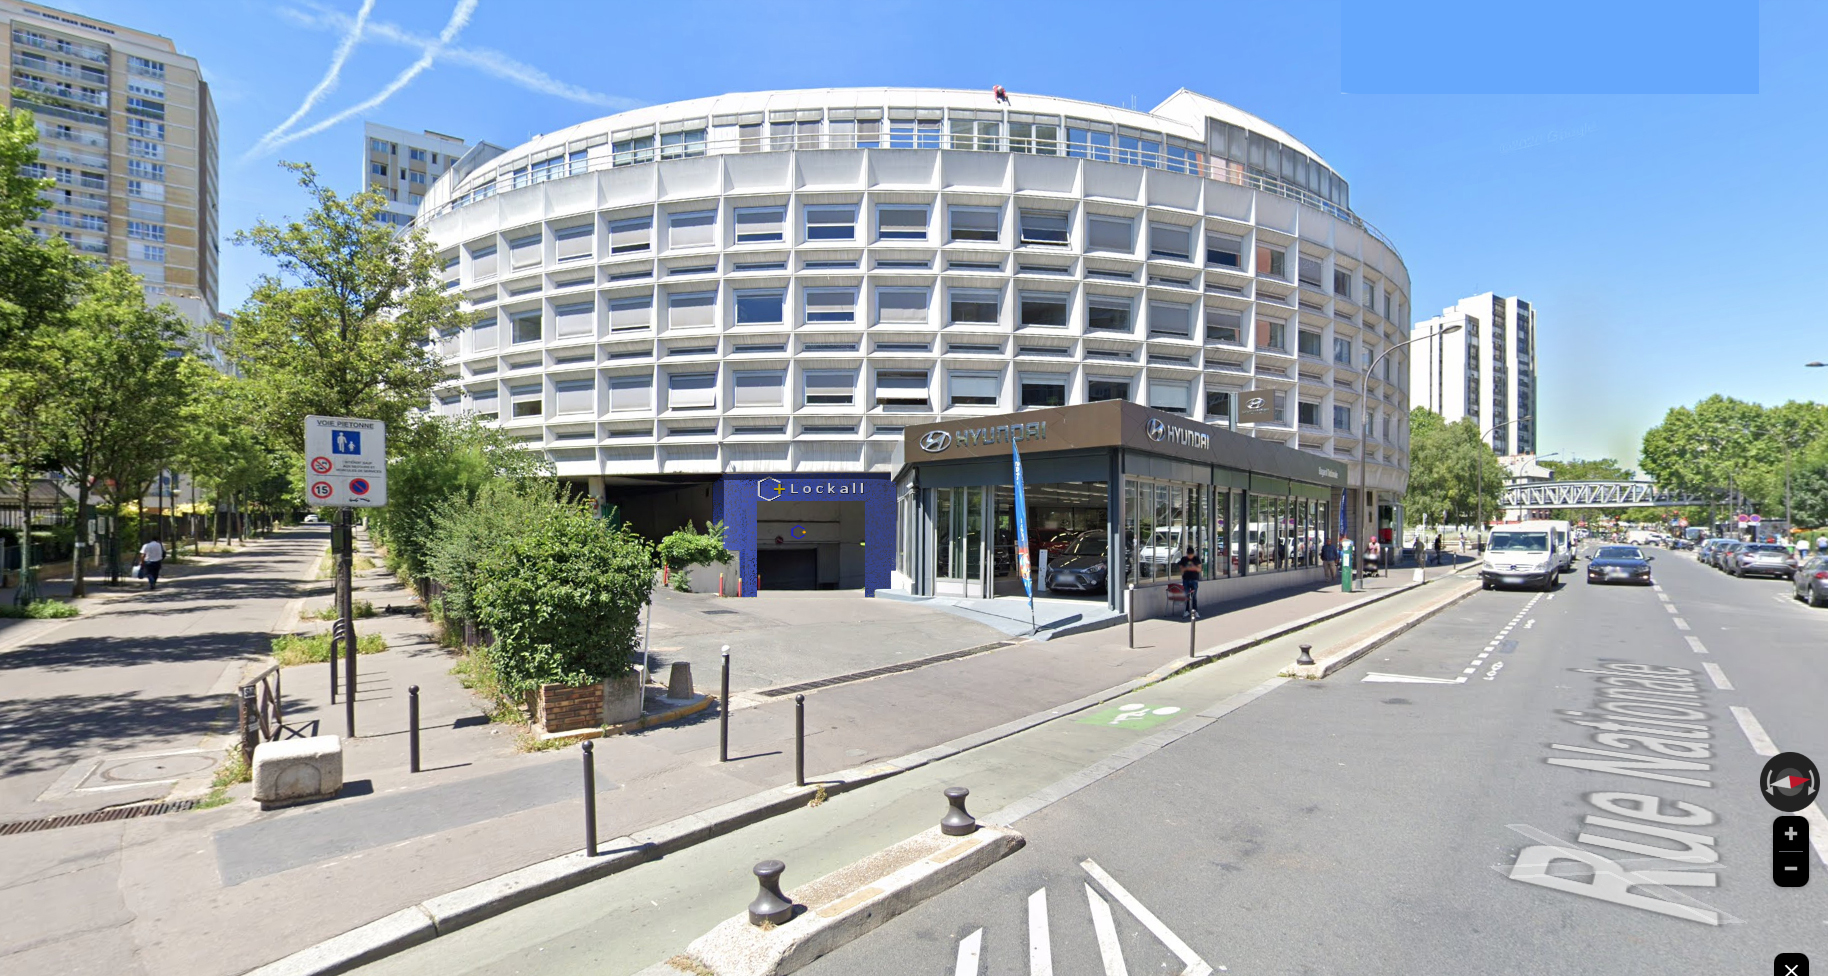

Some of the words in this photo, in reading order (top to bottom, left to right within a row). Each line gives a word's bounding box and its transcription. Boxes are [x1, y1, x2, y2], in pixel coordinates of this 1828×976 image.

[337, 421, 374, 429] PIETONNE
[956, 421, 1046, 448] HYUNDAI
[1167, 425, 1210, 450] HYUNDAI
[315, 486, 329, 494] 15
[790, 482, 865, 494] Lockall
